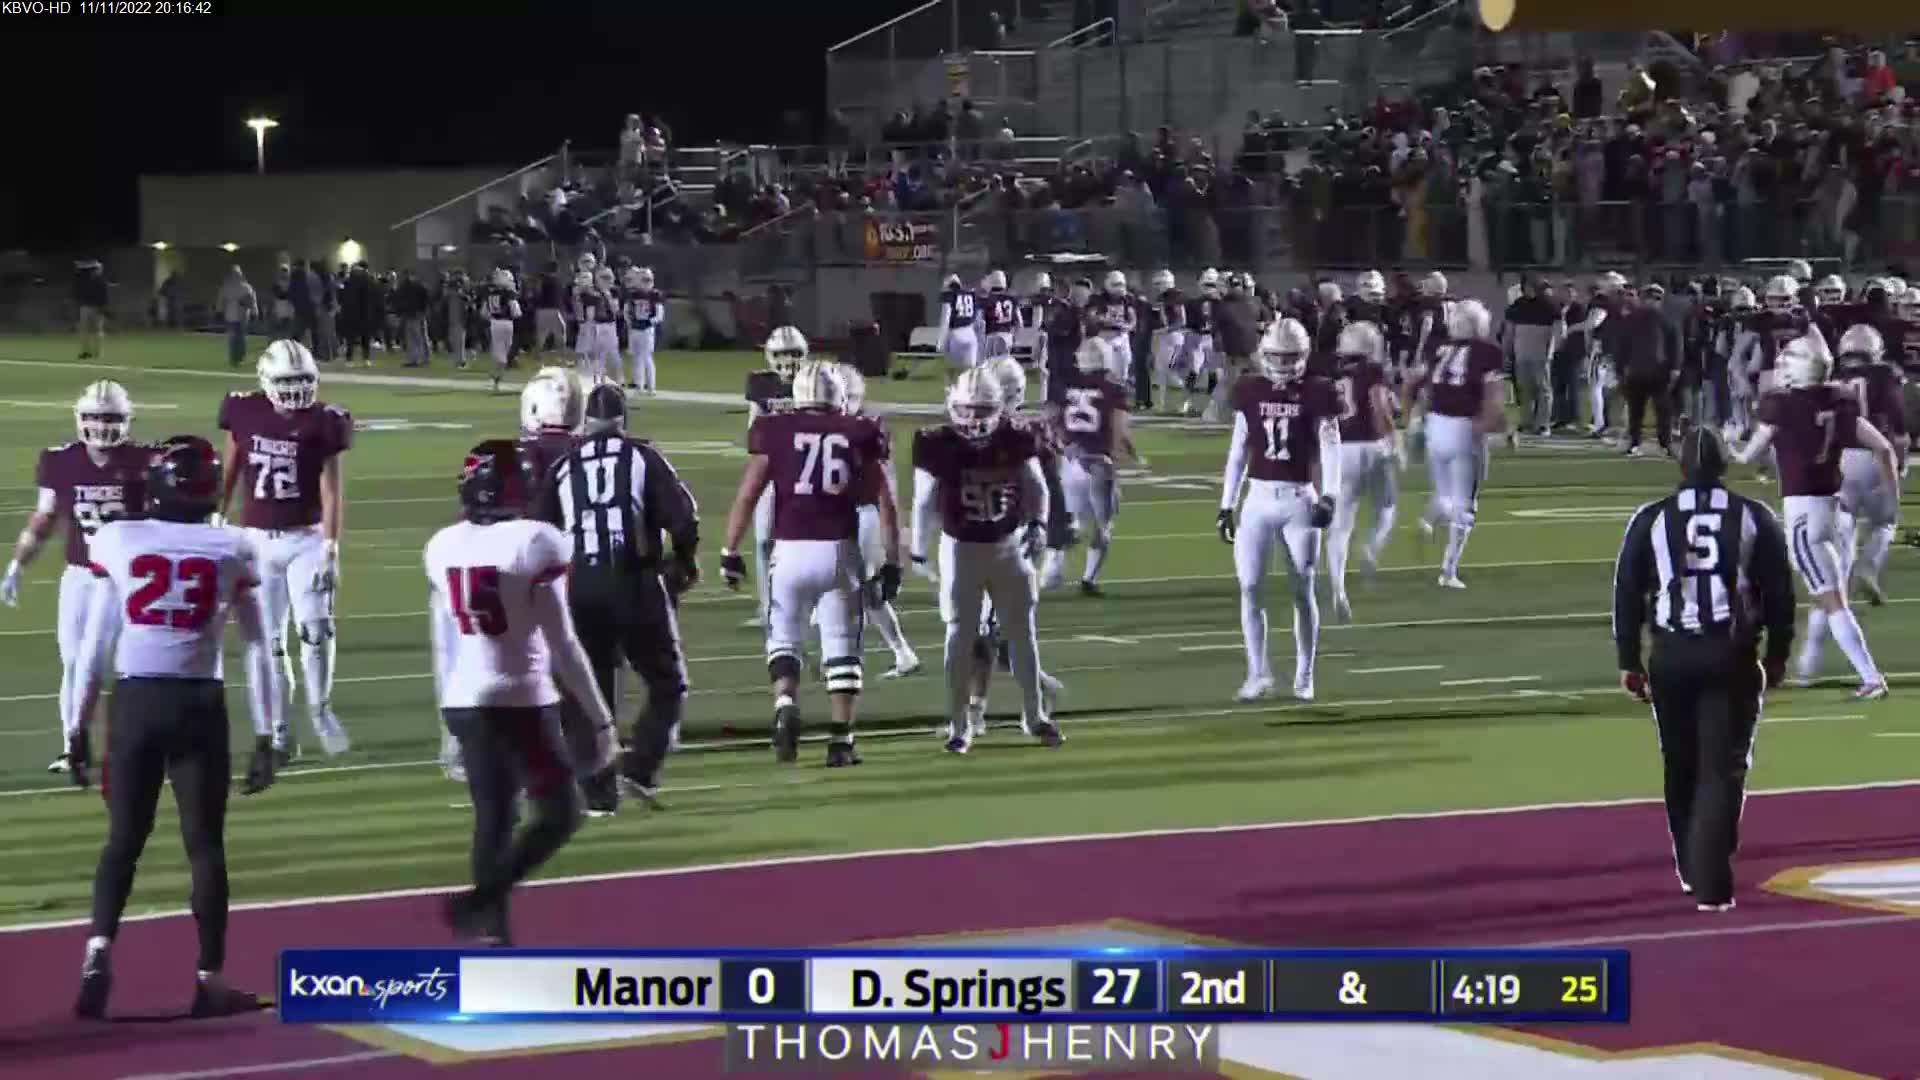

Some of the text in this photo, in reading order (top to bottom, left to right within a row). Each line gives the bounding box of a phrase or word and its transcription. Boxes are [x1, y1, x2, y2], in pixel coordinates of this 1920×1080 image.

[793, 432, 849, 496] 76
[1263, 417, 1291, 460] 11
[248, 453, 300, 499] 72
[582, 456, 619, 504] U
[1685, 514, 1722, 570] S
[126, 554, 218, 628] 23
[446, 566, 508, 635] 15
